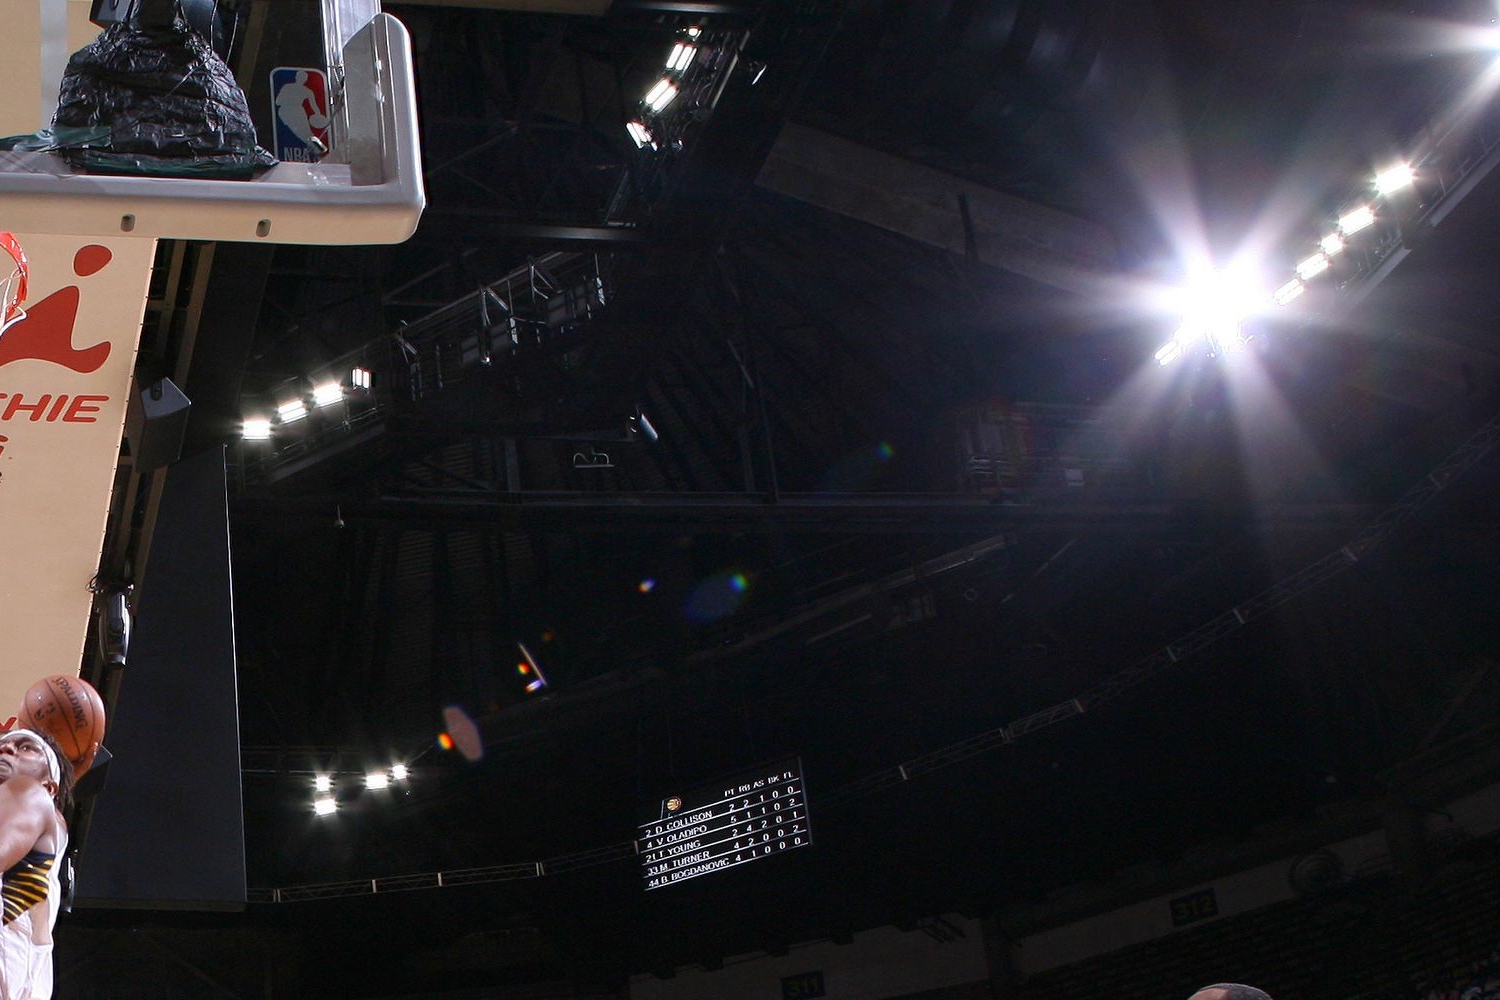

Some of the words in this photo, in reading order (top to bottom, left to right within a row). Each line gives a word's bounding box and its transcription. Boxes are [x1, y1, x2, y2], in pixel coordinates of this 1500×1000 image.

[666, 811, 713, 830] COLLISON
[667, 825, 707, 843] OLADIPO
[667, 840, 701, 856] YOUNG
[672, 850, 711, 867] TURNER
[671, 858, 730, 881] BOGDANOVIC
